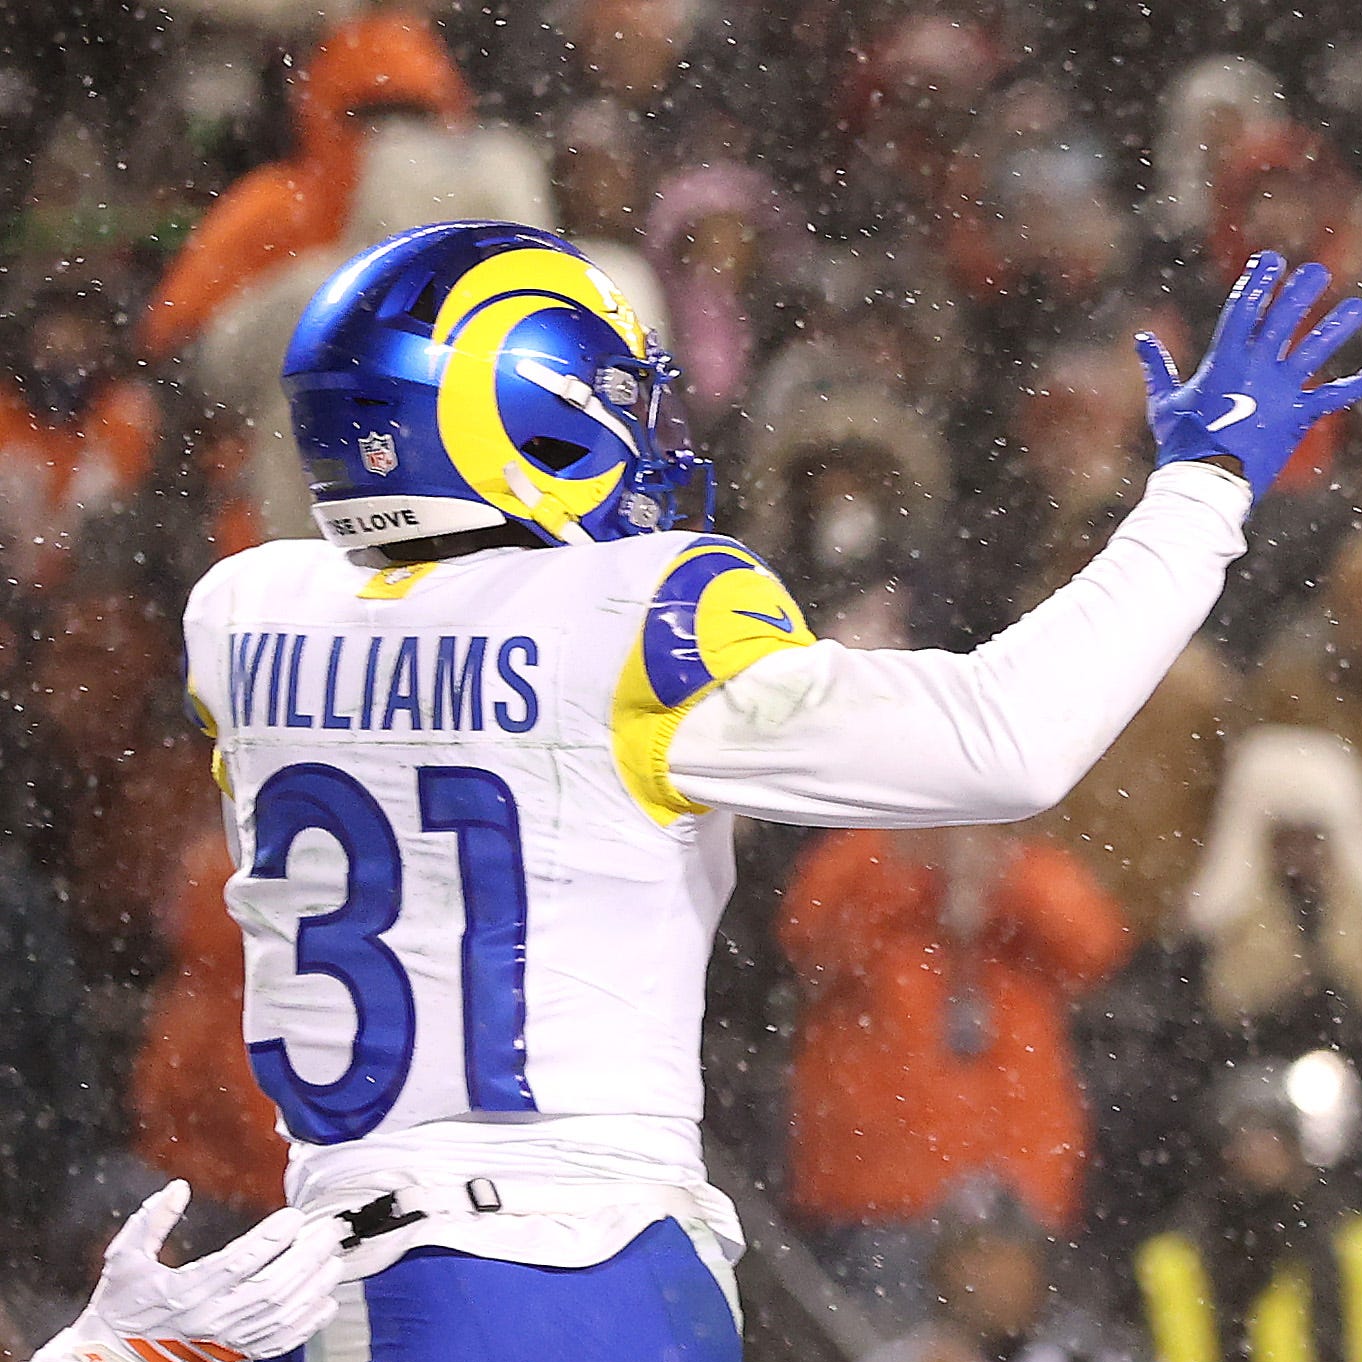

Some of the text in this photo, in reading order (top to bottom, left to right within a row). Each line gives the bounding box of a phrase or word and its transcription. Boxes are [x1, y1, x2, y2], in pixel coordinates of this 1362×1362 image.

[357, 509, 420, 533] LOVE
[229, 632, 540, 734] WILLIAMS
[247, 761, 540, 1146] 31
